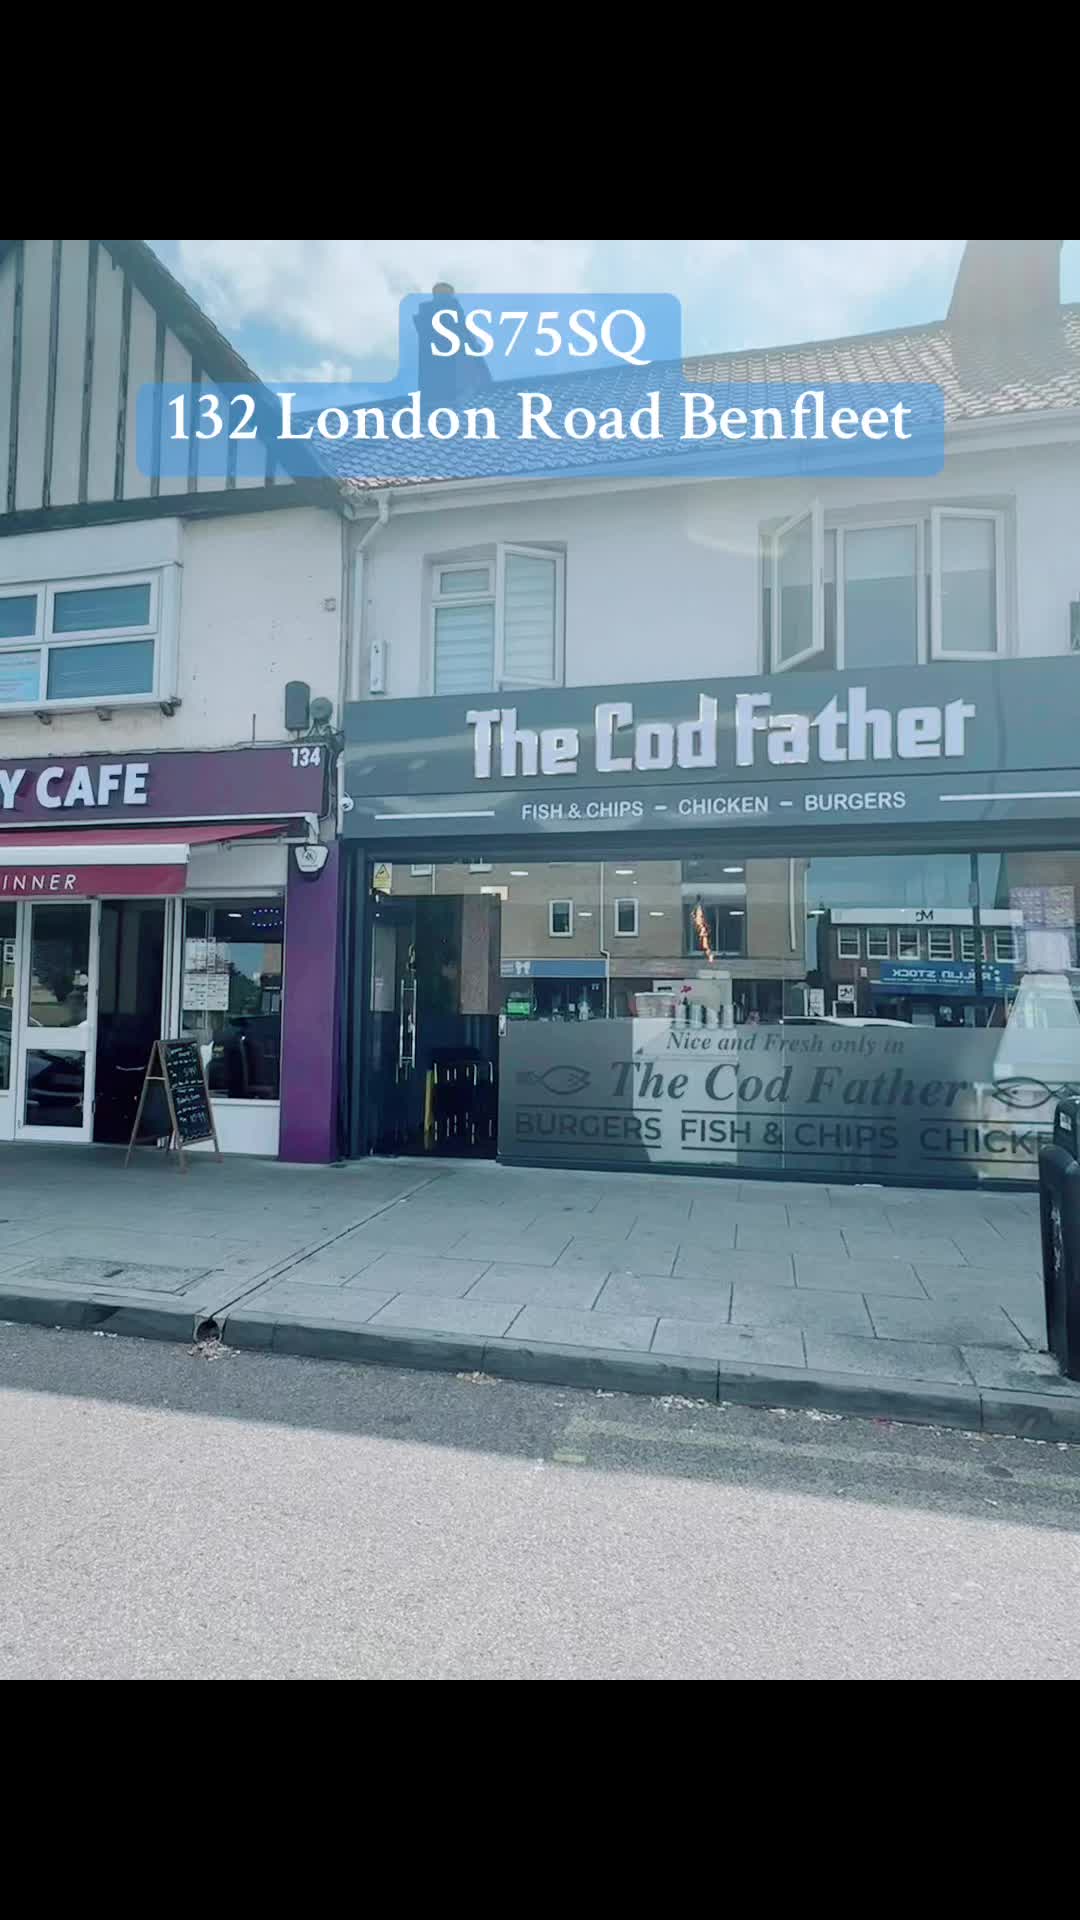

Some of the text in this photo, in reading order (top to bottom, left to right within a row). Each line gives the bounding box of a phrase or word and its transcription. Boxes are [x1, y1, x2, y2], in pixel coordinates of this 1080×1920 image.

[466, 686, 976, 779] The Cod Father
[290, 747, 322, 768] 134
[36, 762, 150, 809] CAFE
[521, 803, 565, 821] FISH
[585, 800, 644, 819] CHIPS
[678, 796, 769, 816] CHICKEN
[804, 791, 906, 811] BURGERS
[666, 1031, 905, 1056] Nice and Fresh only in
[611, 1061, 969, 1107] The Cod Father
[515, 1111, 662, 1141] BURGERS
[681, 1118, 751, 1144] FISH
[763, 1121, 783, 1146] &
[794, 1122, 898, 1149] CHIPS
